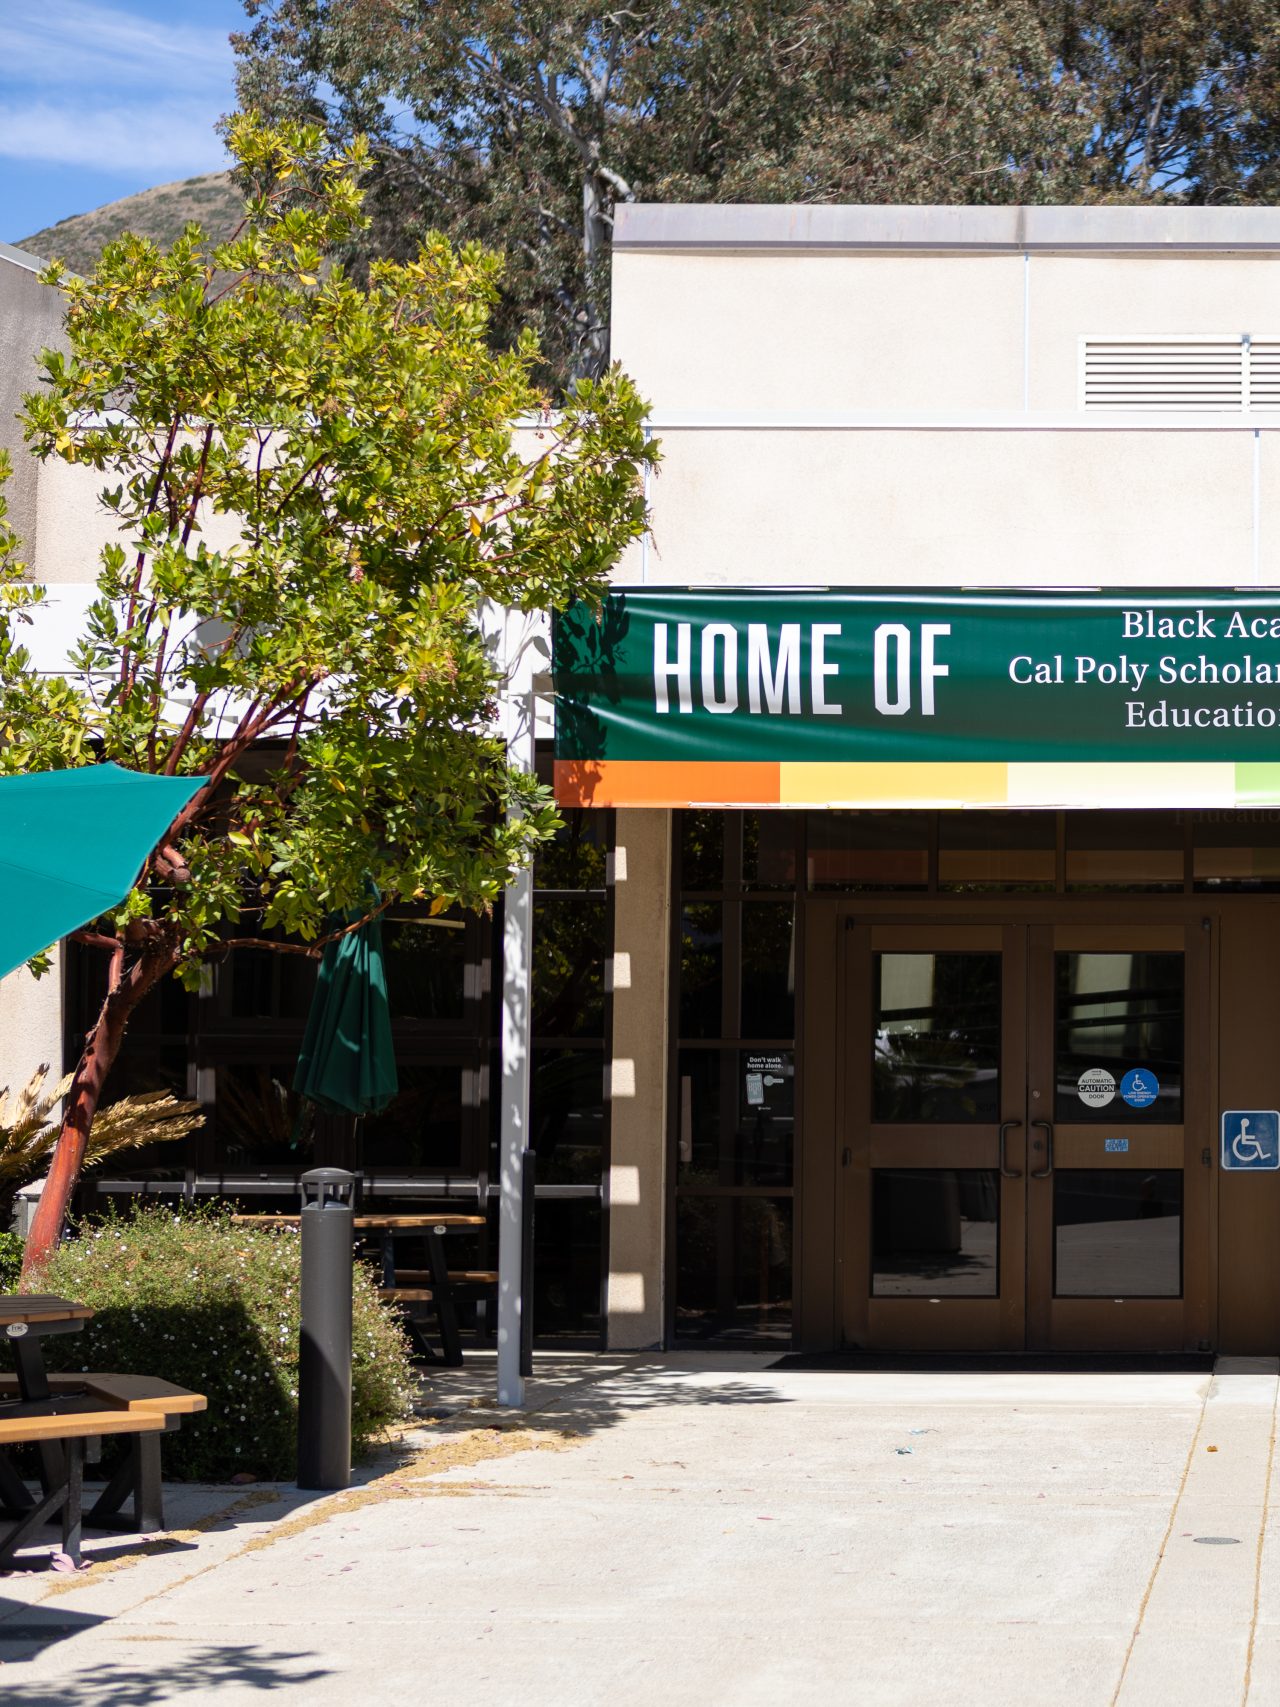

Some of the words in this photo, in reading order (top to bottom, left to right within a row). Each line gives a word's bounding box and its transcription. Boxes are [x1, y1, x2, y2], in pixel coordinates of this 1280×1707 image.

[1122, 610, 1217, 638] Black
[653, 623, 842, 716] HOME
[873, 623, 951, 716] OF
[1008, 655, 1064, 683] Cal
[1074, 655, 1149, 692] Poly
